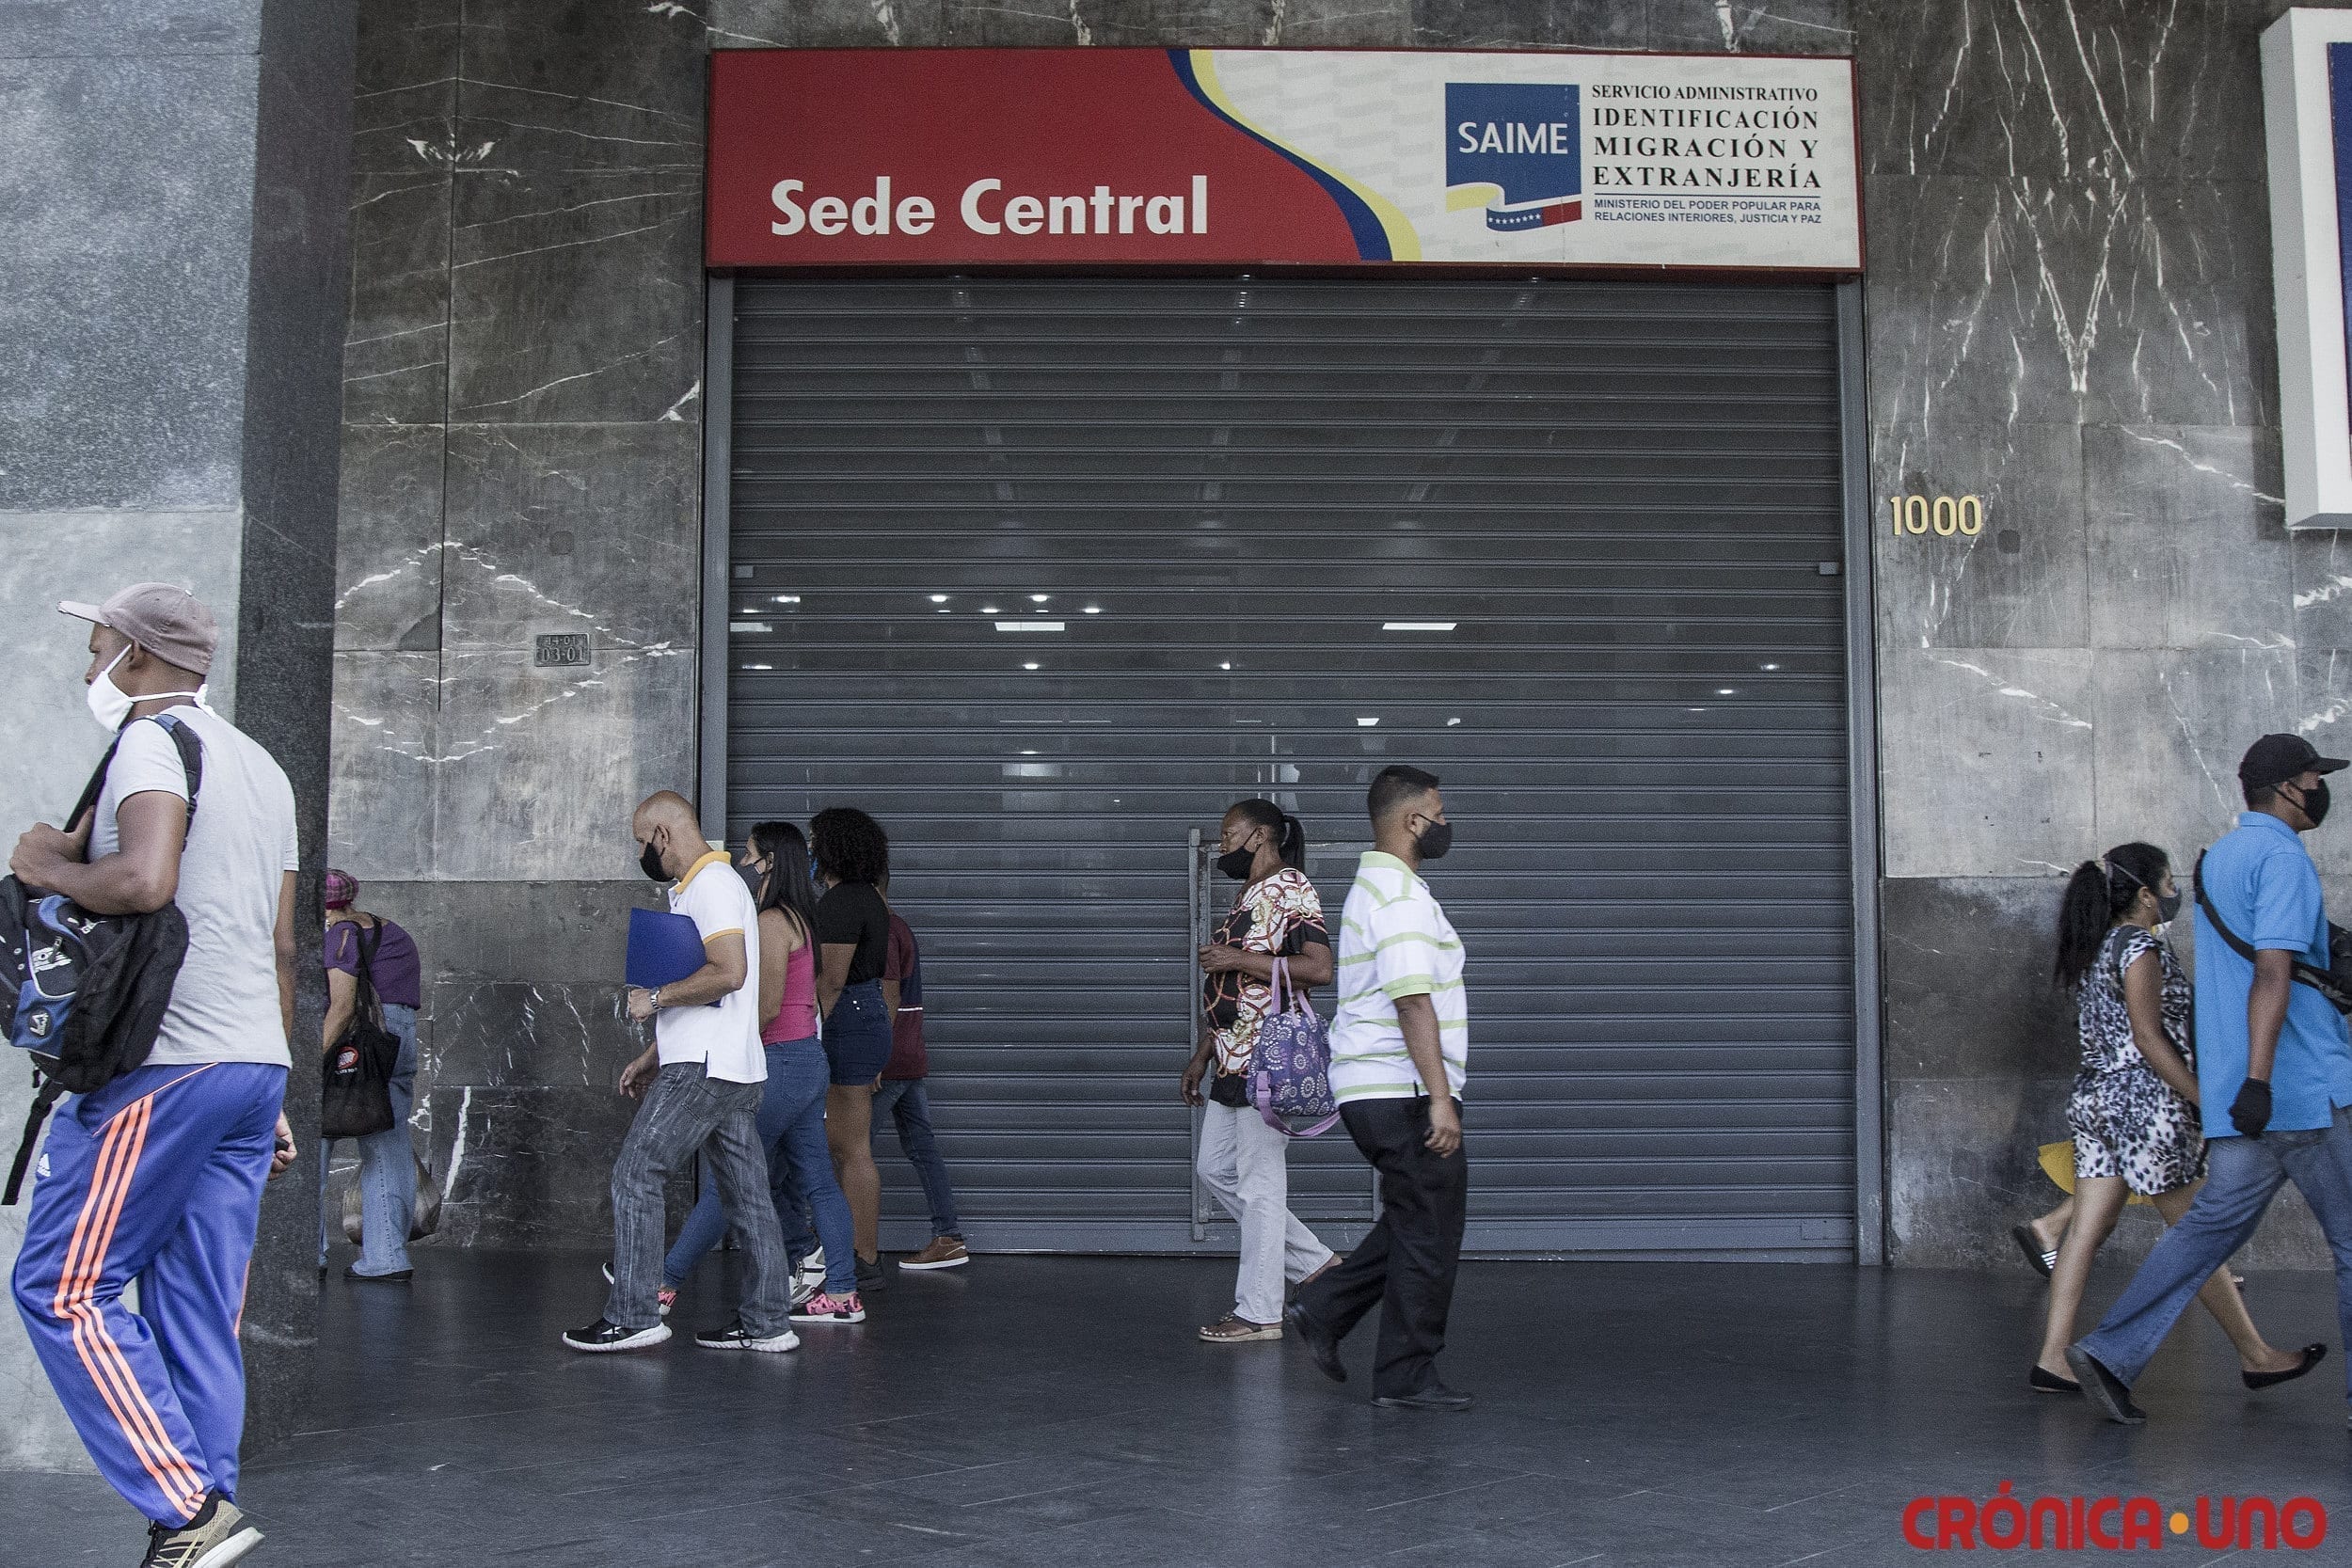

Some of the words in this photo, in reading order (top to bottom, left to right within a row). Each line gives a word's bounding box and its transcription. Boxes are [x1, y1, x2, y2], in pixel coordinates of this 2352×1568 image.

[1592, 85, 1671, 99] SERVICIO
[1675, 86, 1819, 102] ADMINISTRATIVO
[1593, 105, 1819, 130] IDENTIFICACIÓN
[1458, 121, 1568, 154] SAIME
[1594, 134, 1787, 159] MIGRACIÓN
[1799, 139, 1819, 159] Y
[1593, 163, 1822, 189] EXTRANJERÍA
[771, 176, 936, 236] Sede
[960, 175, 1208, 235] Central
[1594, 198, 1661, 210] MINISTERIO
[1663, 199, 1686, 210] DEL
[1689, 200, 1729, 211] PODER
[1732, 200, 1788, 212] POPULAR
[1789, 201, 1821, 212] PARA
[1594, 212, 1666, 222] RELACIONES
[1668, 213, 1737, 224] INTERIORES,
[1740, 214, 1789, 224] JUSTICIA
[1790, 214, 1798, 224] Y
[1801, 214, 1822, 224] PAZ
[1890, 495, 1982, 536] 1000
